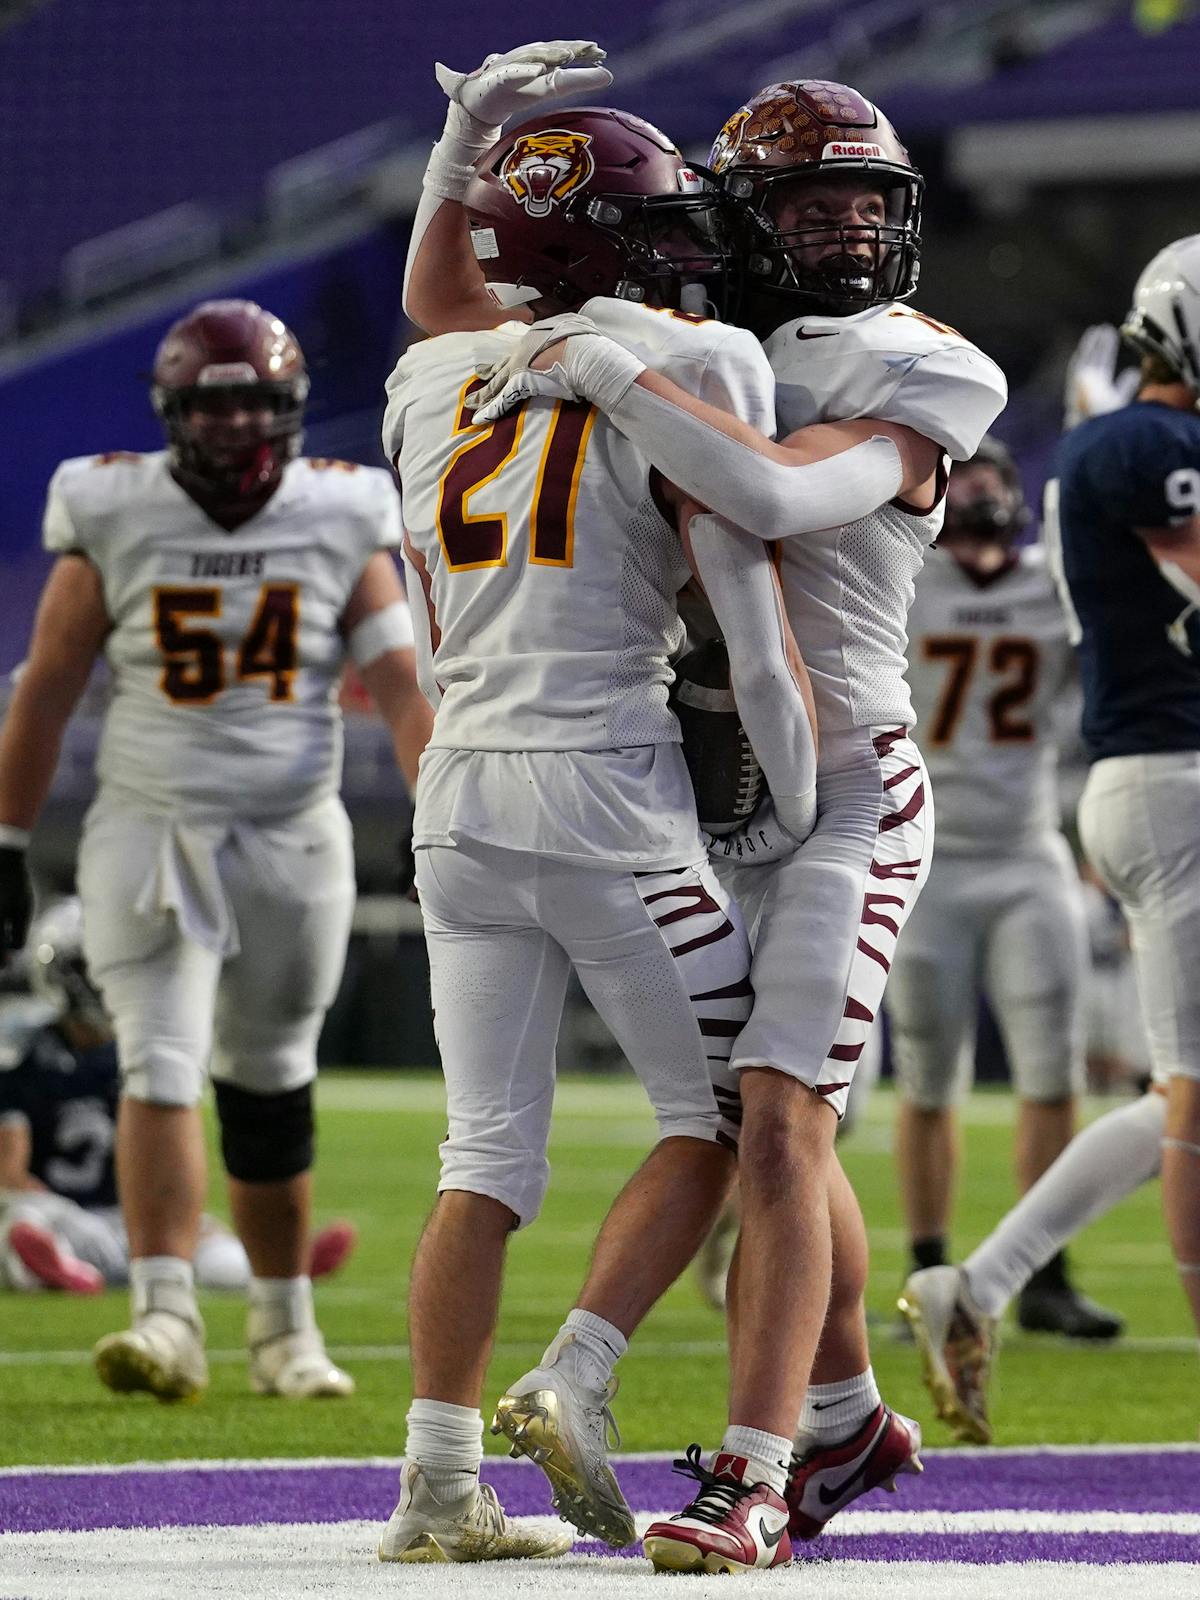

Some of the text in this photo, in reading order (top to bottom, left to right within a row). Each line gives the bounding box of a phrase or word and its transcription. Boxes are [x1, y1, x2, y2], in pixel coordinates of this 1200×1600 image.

[832, 144, 880, 157] Riddell
[436, 373, 598, 573] 21
[153, 582, 302, 705] 54
[919, 635, 1041, 745] 72
